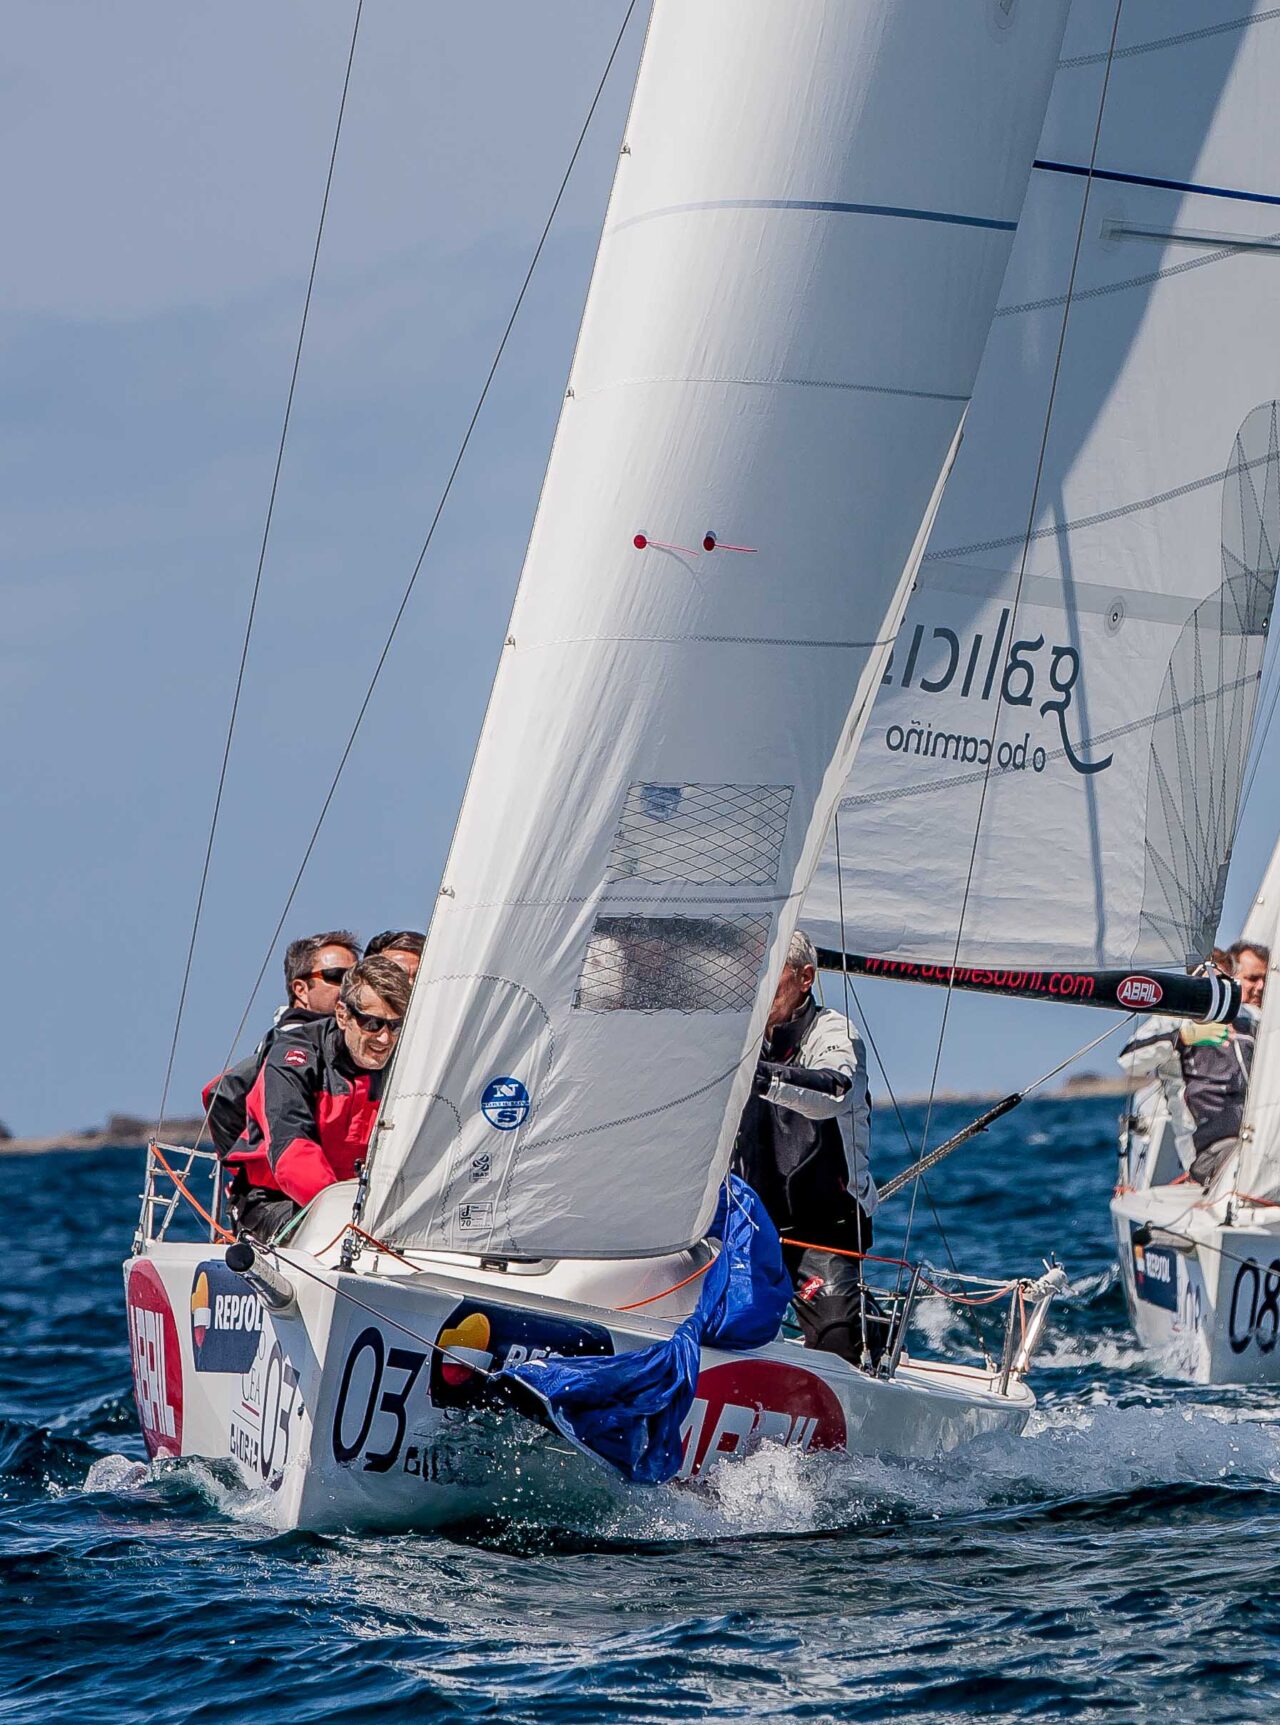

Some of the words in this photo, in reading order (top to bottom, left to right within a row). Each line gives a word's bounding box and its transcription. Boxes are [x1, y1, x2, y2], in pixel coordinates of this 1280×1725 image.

[1122, 981, 1157, 1003] ABRIL
[497, 1110, 518, 1123] S
[460, 1219, 472, 1227] 70
[214, 1294, 262, 1332] REPSOL
[333, 1327, 427, 1474] 03
